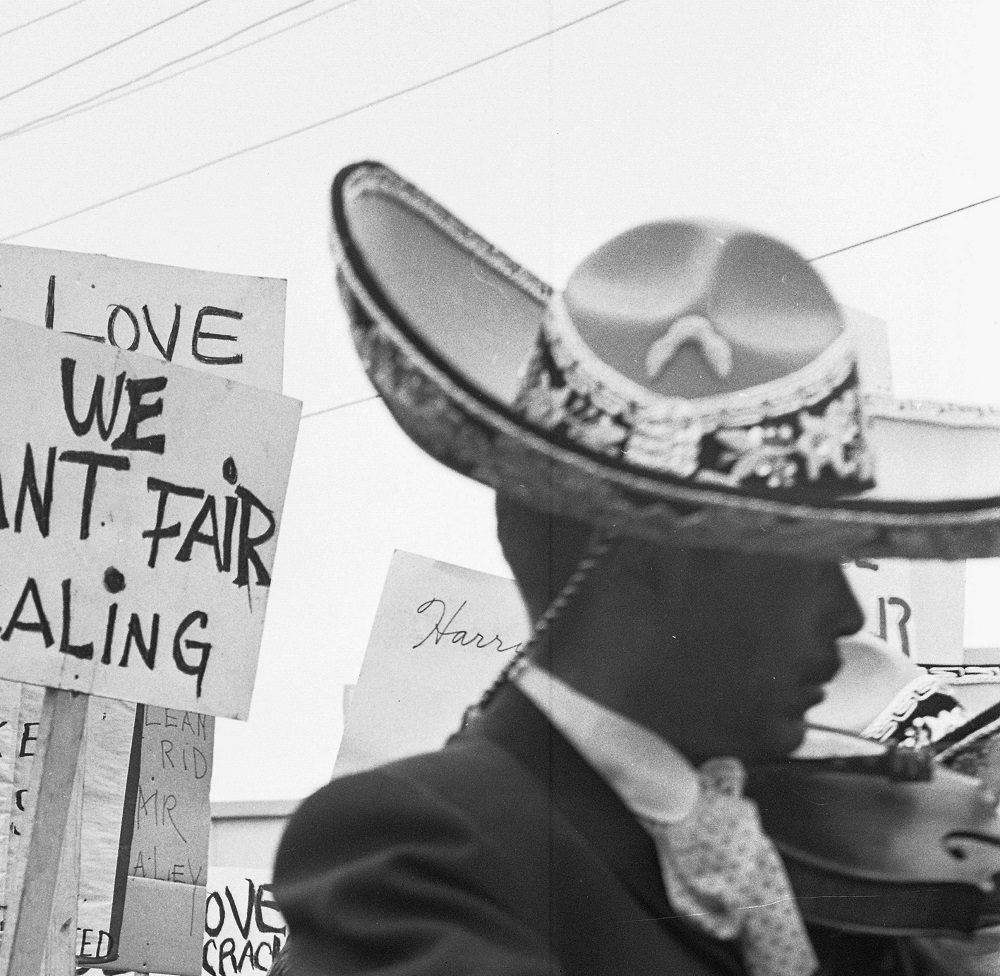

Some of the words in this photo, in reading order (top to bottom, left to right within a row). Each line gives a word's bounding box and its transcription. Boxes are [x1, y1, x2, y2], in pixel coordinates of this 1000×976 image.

[45, 275, 243, 364] LOVE
[61, 357, 168, 455] WE
[160, 739, 208, 780] RID
